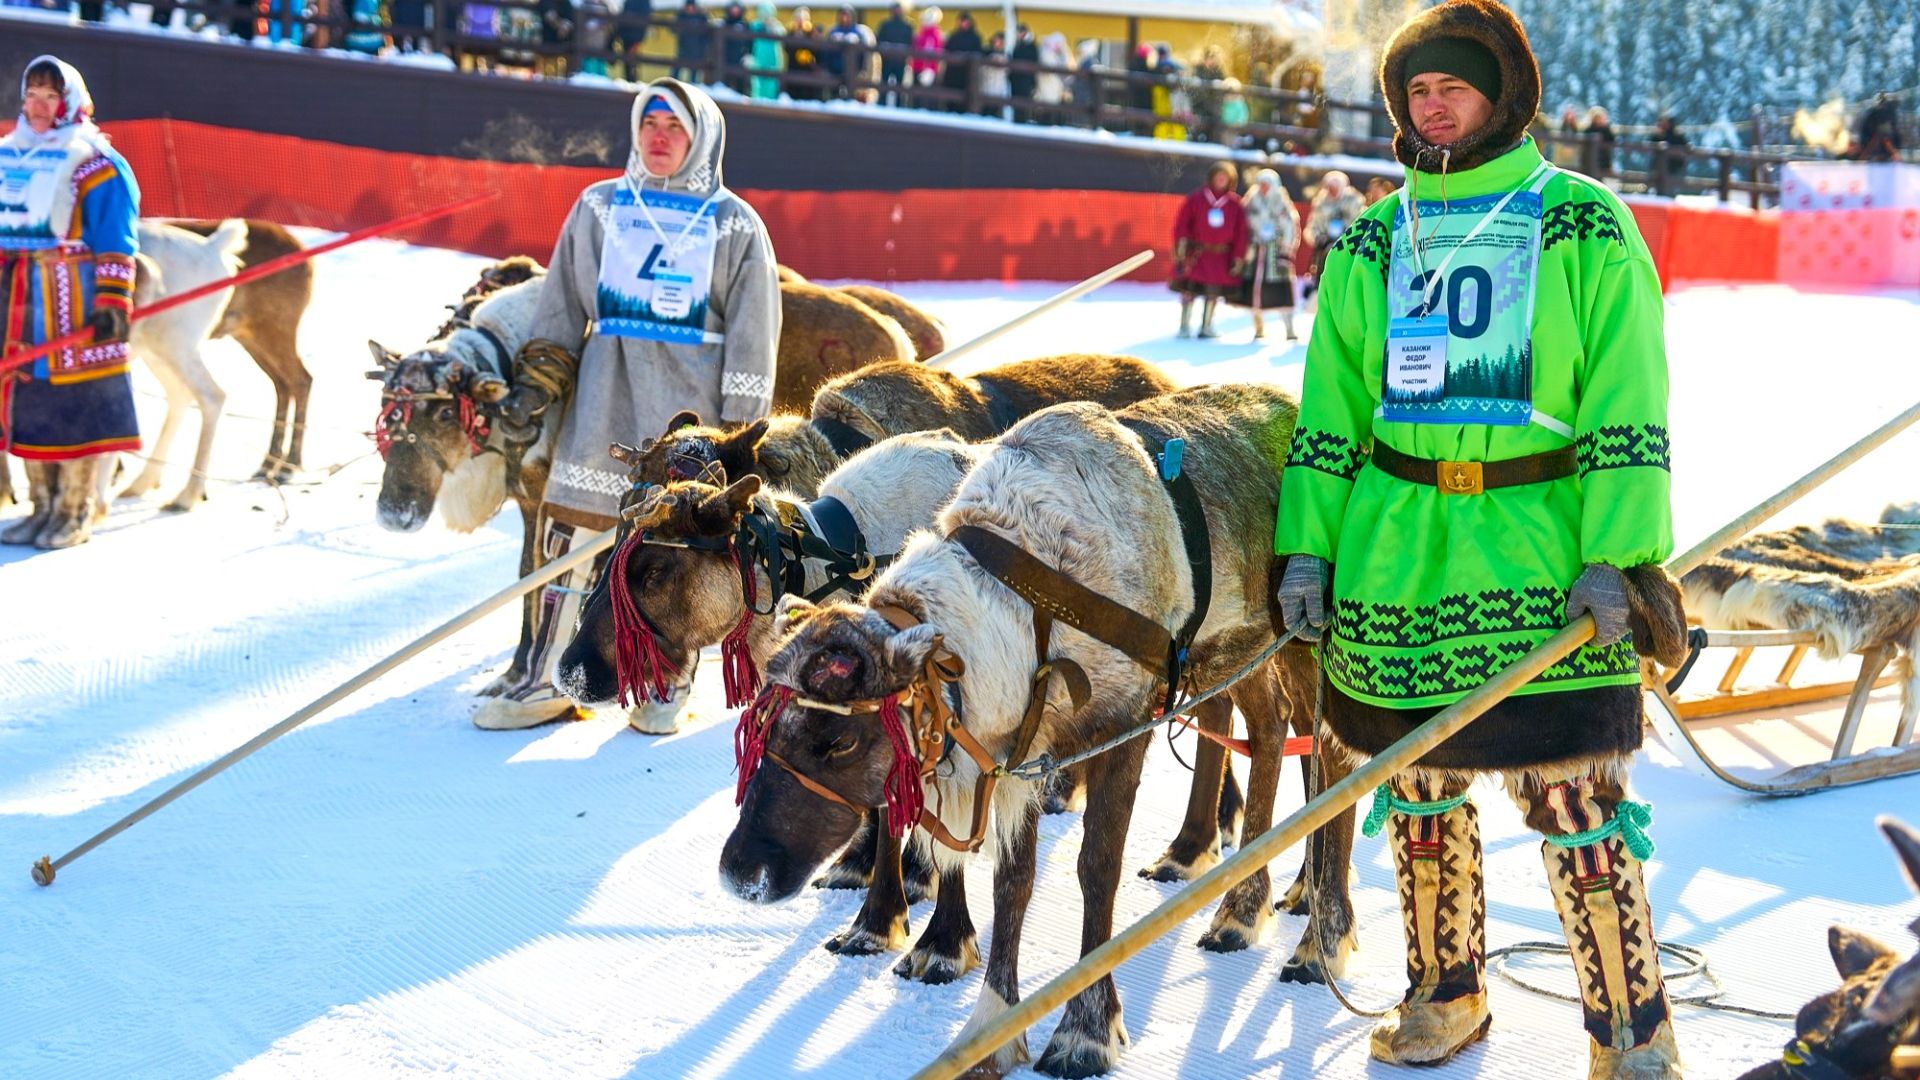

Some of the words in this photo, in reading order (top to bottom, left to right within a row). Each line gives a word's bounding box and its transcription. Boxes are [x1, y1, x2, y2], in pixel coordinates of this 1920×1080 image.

[1406, 265, 1493, 339] 20
[1405, 354, 1427, 362] ФЕДОР
[1399, 363, 1432, 371] ИВАНОВИЧ
